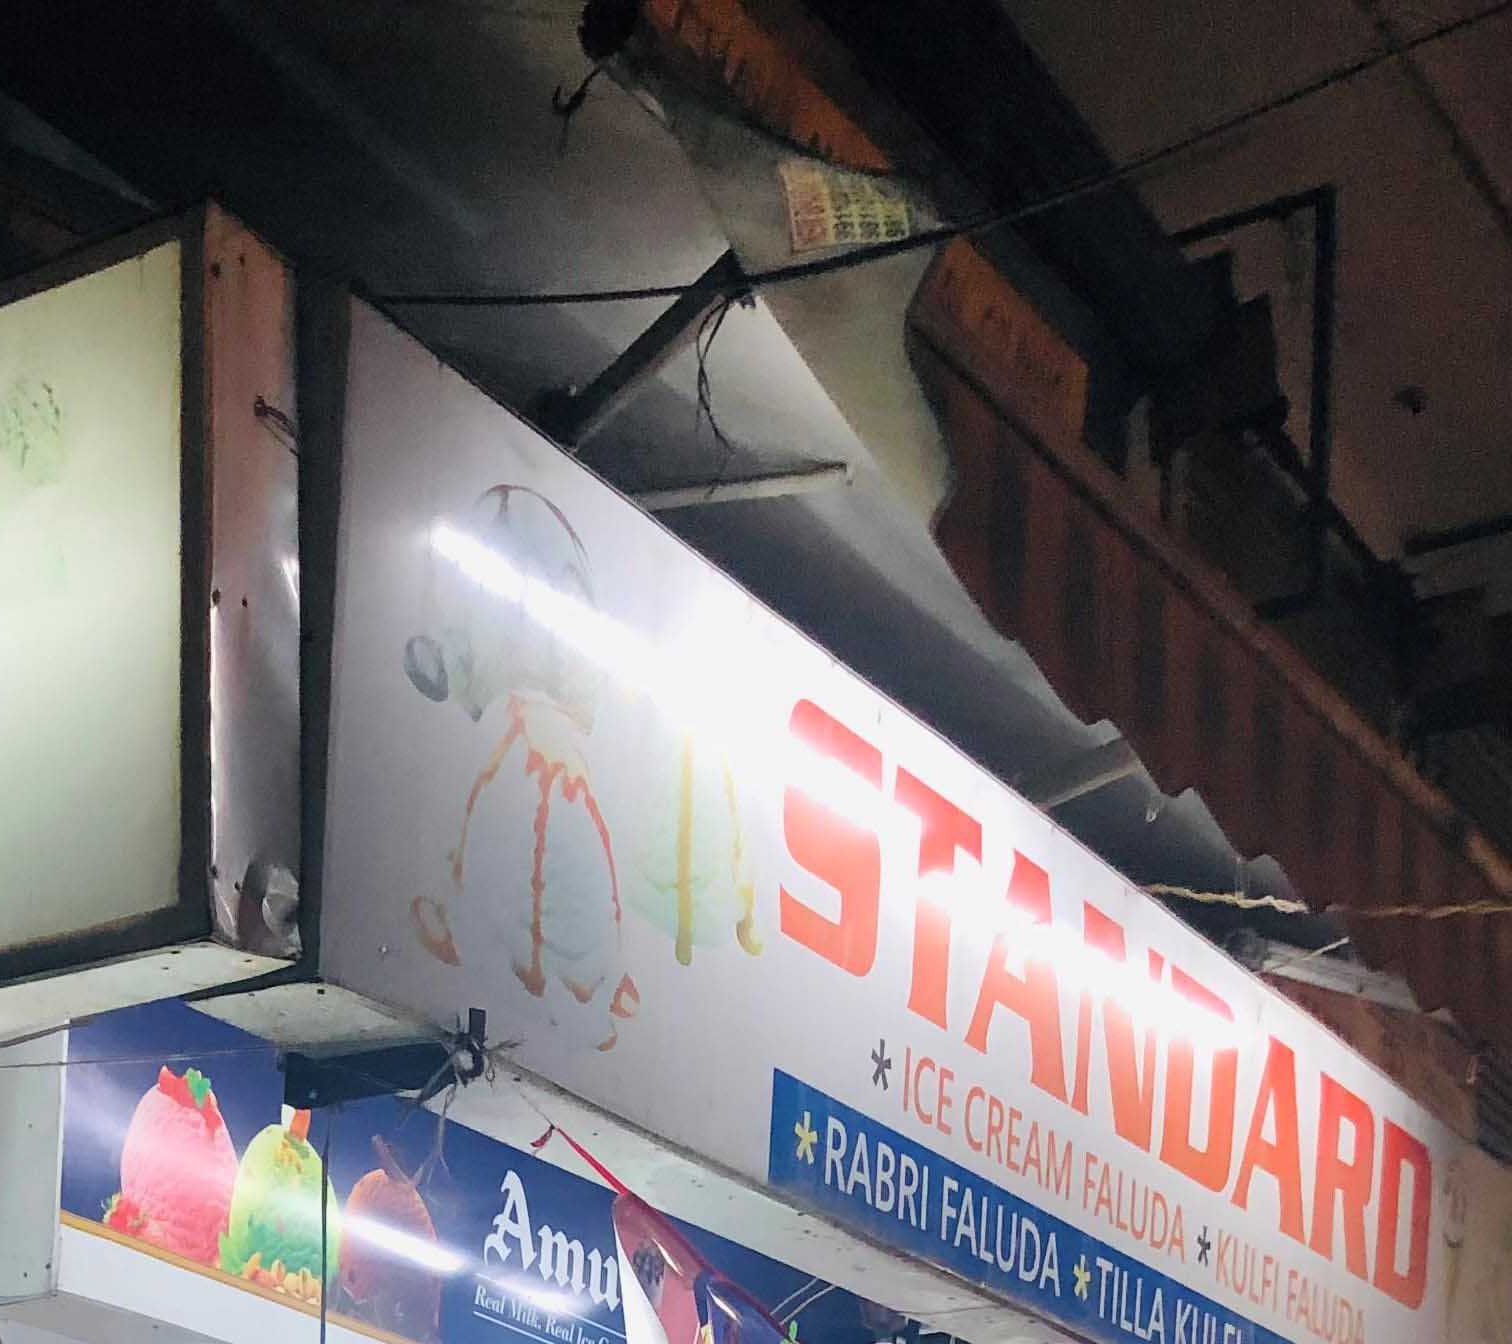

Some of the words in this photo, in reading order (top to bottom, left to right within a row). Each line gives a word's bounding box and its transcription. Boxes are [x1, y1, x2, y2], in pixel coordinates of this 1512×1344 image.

[779, 698, 1431, 1311] STANDARD
[484, 1170, 621, 1312] Amu
[824, 1117, 929, 1231] RABRI
[941, 1175, 1061, 1297] FALUDA
[904, 1046, 955, 1133] ICE
[964, 1085, 1073, 1196] CREAM
[1083, 1153, 1186, 1263] FALUDA
[1216, 1230, 1280, 1310] KULFI
[474, 1284, 505, 1316] Real
[545, 1317, 575, 1342] Real
